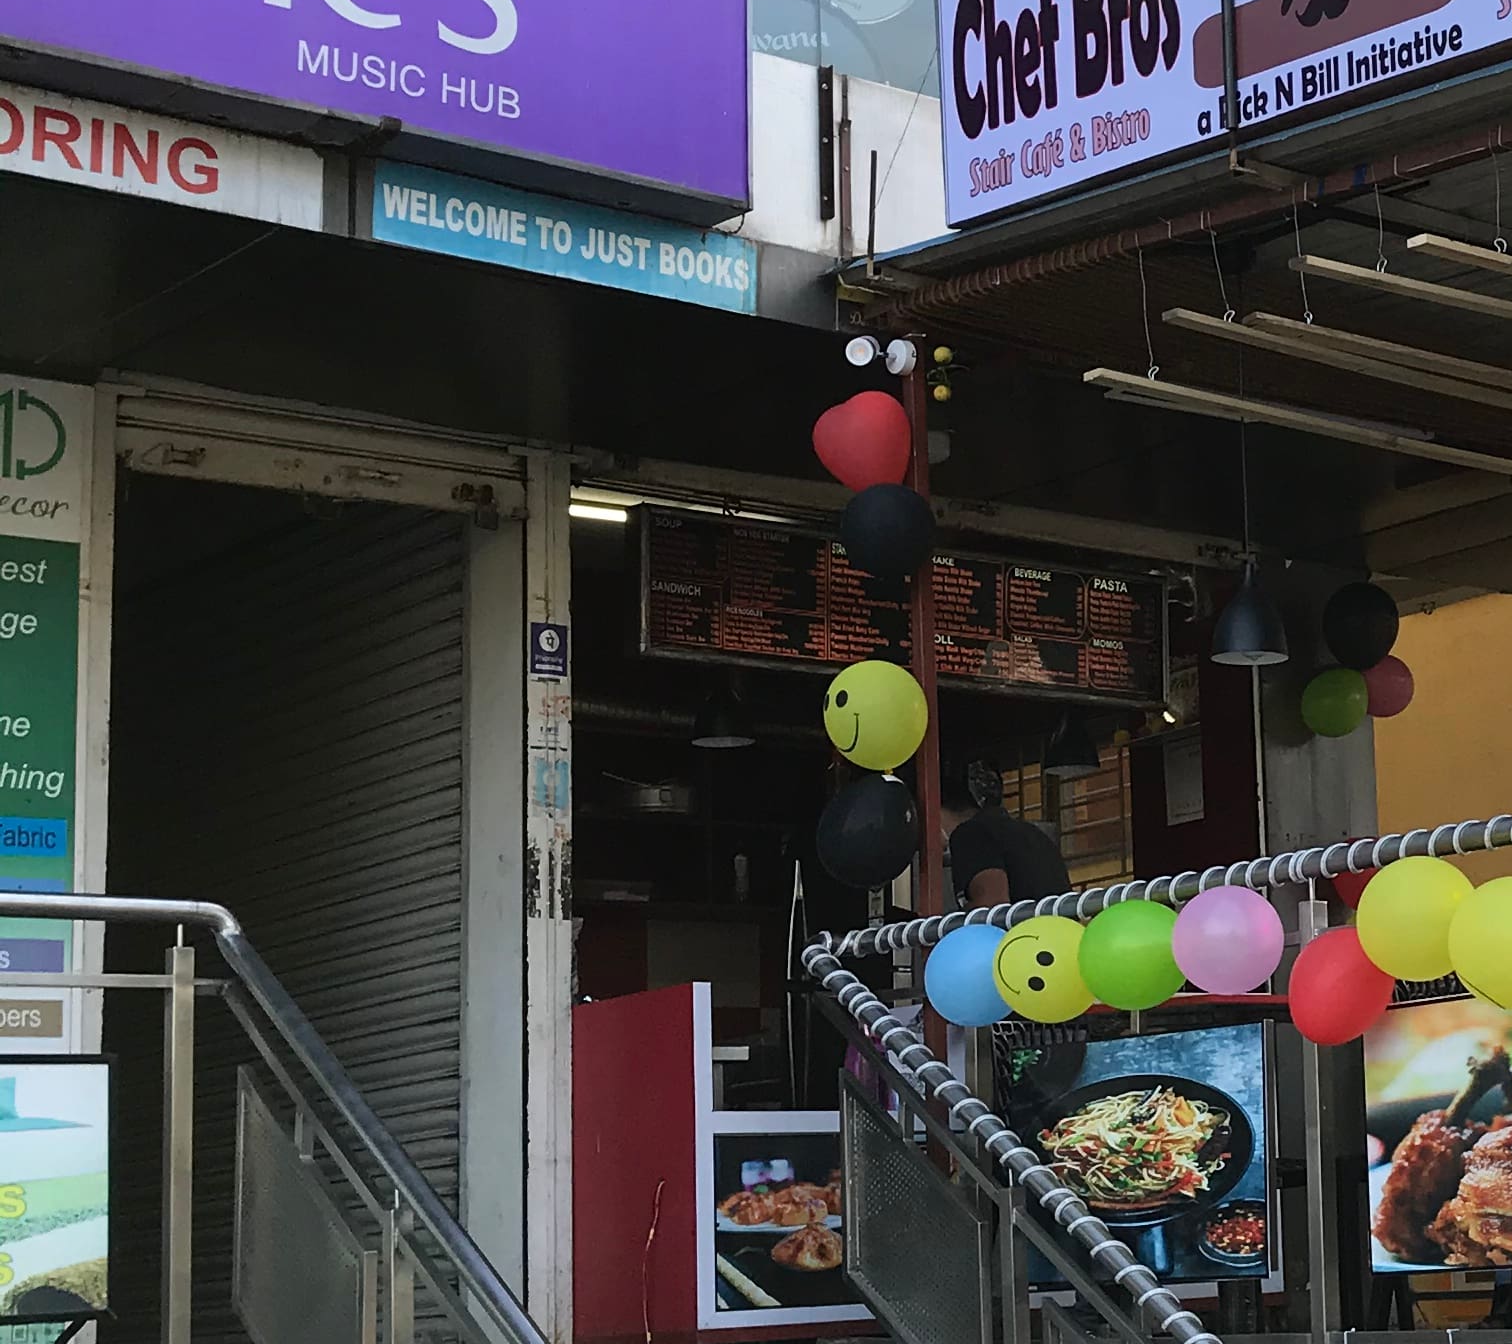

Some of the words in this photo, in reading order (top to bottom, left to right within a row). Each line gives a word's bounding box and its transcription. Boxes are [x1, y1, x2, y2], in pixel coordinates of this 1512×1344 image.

[298, 40, 427, 98] MUSIC
[441, 74, 521, 119] HUB
[1197, 110, 1211, 136] a
[1275, 72, 1293, 111] N
[1302, 55, 1340, 102] Bill
[1347, 24, 1462, 87] Initiative
[970, 149, 1015, 197] Stair
[1021, 129, 1064, 178] Café
[1069, 123, 1086, 162] &
[1091, 108, 1150, 157] Bistro
[382, 183, 527, 247] WELCOME
[535, 215, 573, 255] TO
[580, 227, 651, 271] JUST
[660, 243, 750, 292] BOOKS
[650, 579, 702, 597] SANDWICH
[1014, 567, 1052, 582] BEVERAGE
[1093, 578, 1128, 593] PASTA
